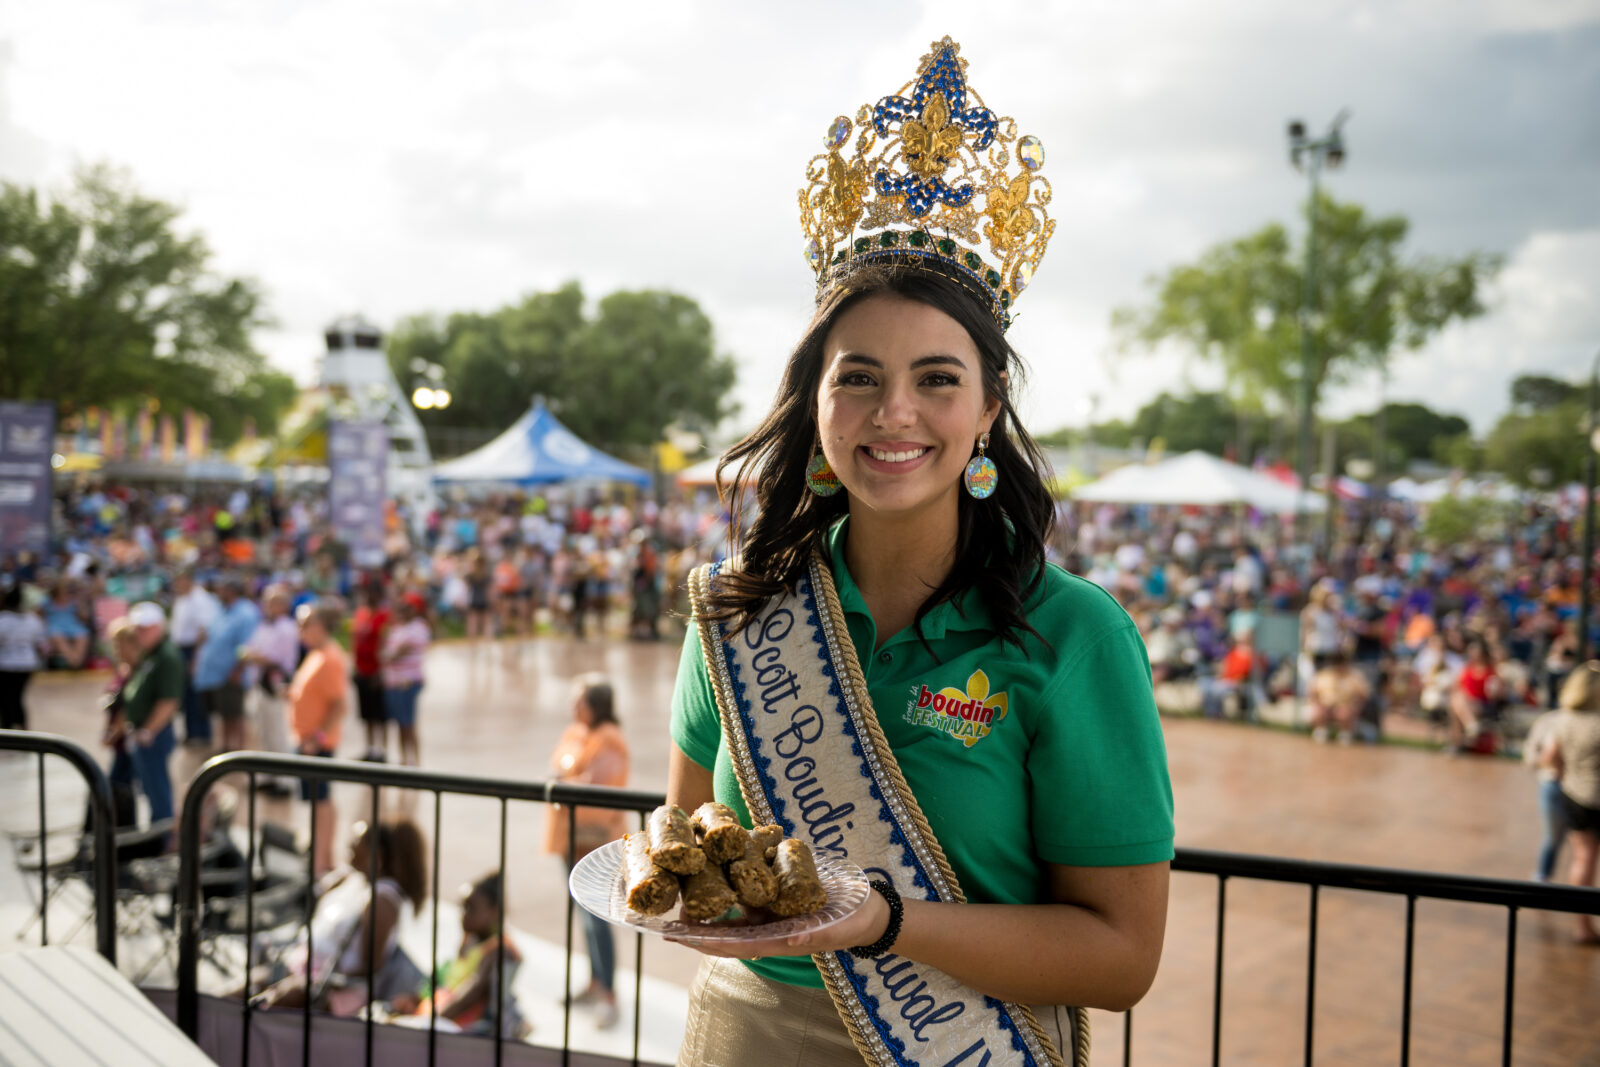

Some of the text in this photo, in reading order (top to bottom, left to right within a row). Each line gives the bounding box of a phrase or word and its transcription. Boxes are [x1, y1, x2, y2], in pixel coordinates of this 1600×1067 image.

[744, 608, 802, 714] Scott
[911, 707, 986, 739] FESTIVAL
[916, 683, 995, 724] boudin
